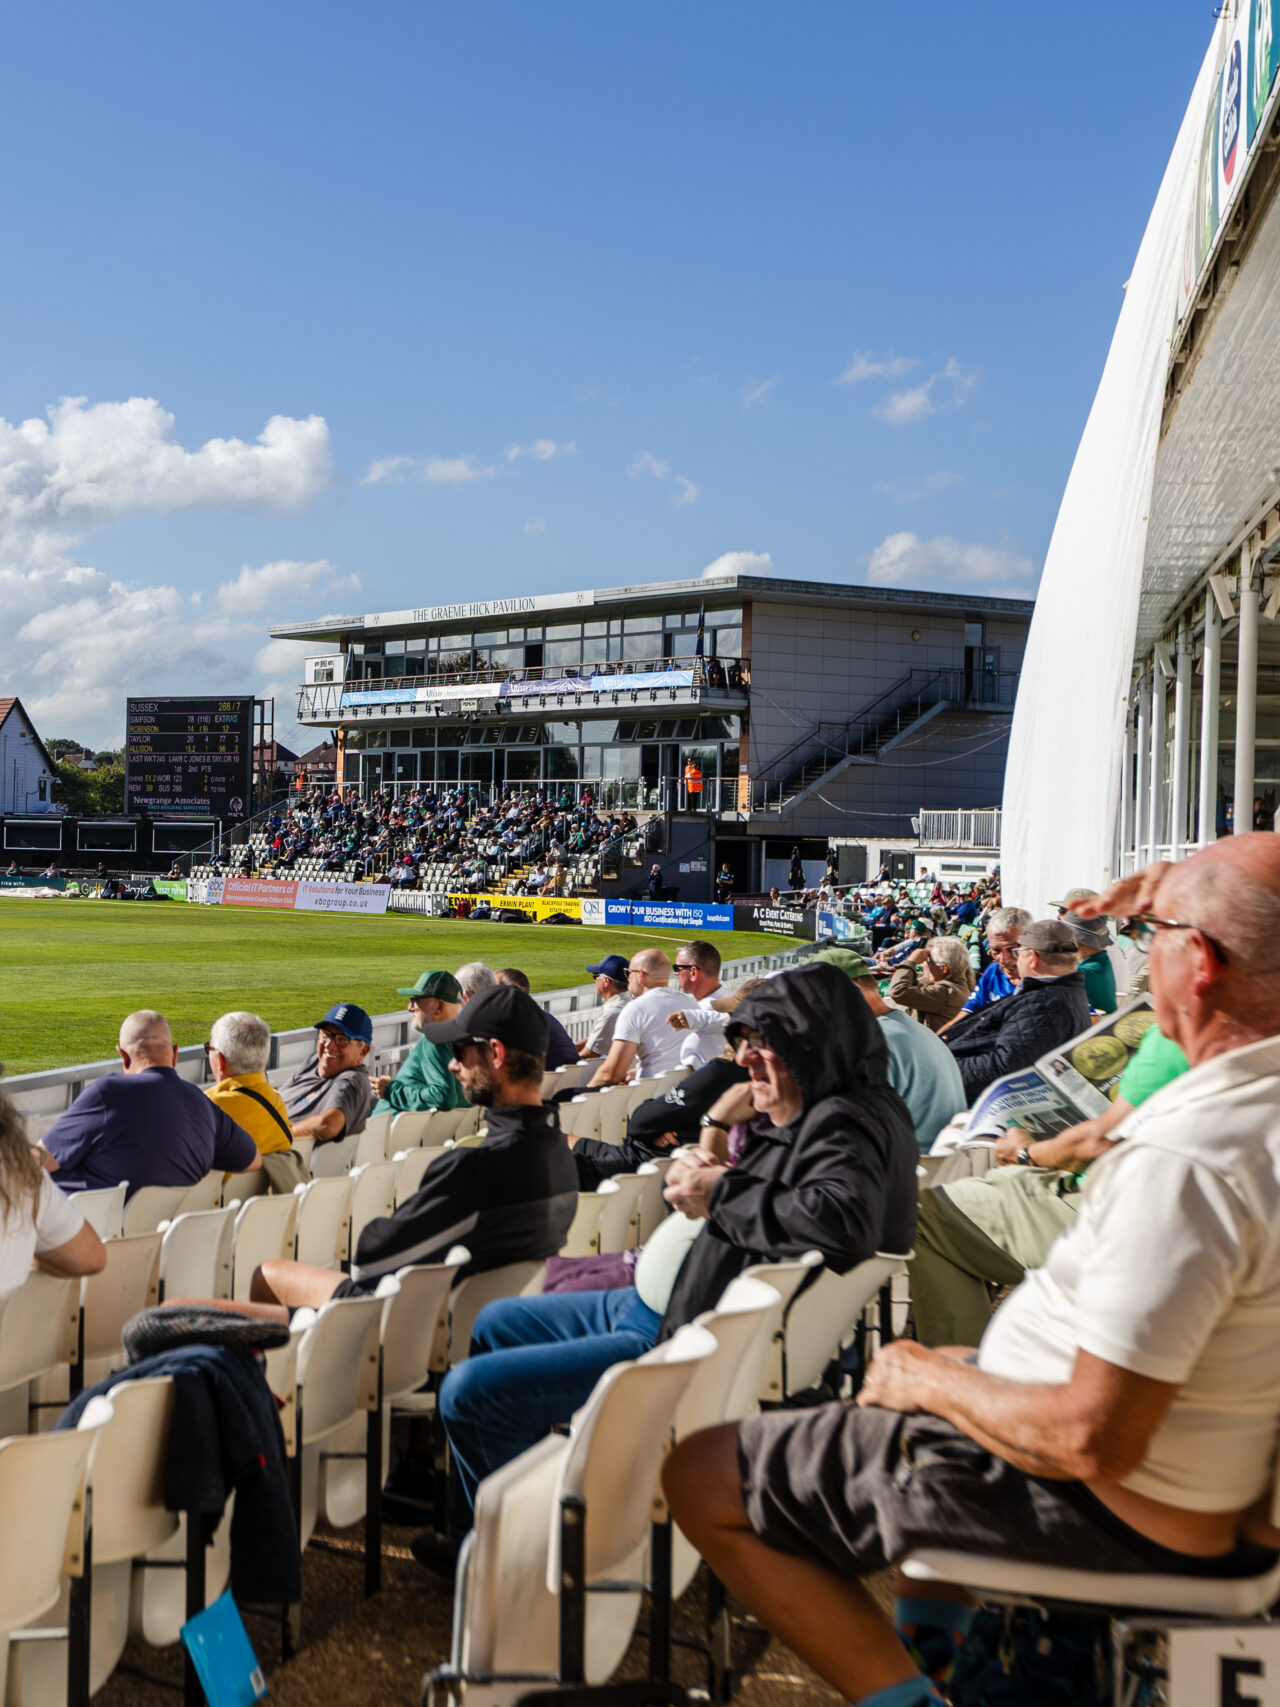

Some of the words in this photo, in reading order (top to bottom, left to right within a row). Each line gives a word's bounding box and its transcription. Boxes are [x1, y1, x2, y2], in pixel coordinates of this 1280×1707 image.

[412, 609, 428, 622] THE
[431, 606, 467, 620] GRAEME
[469, 603, 491, 616] HICK
[492, 598, 536, 614] PAVILION
[130, 703, 159, 712] SUSSEX
[214, 715, 238, 723] EXTRAS
[129, 725, 159, 733] ROBINSON
[157, 774, 170, 782] WOR
[158, 784, 170, 792] SUS
[133, 796, 171, 805] Newgrange
[174, 797, 210, 805] Associates
[209, 879, 224, 891] ebc
[228, 881, 252, 892] Official
[251, 882, 258, 892] IT
[258, 883, 286, 894] Partners
[286, 883, 296, 895] of
[309, 885, 335, 894] Solutions
[335, 886, 344, 895] for
[344, 887, 358, 895] Your
[358, 887, 385, 896] Business
[314, 896, 368, 909] ebcgroup.co.uk
[500, 900, 518, 908] ERMIN
[518, 901, 535, 909] PLANT
[607, 904, 626, 914] GROW
[646, 906, 675, 917] BUSINESS
[675, 908, 692, 918] WITH
[692, 909, 703, 918] ISO
[753, 907, 759, 918] A
[759, 908, 765, 918] C
